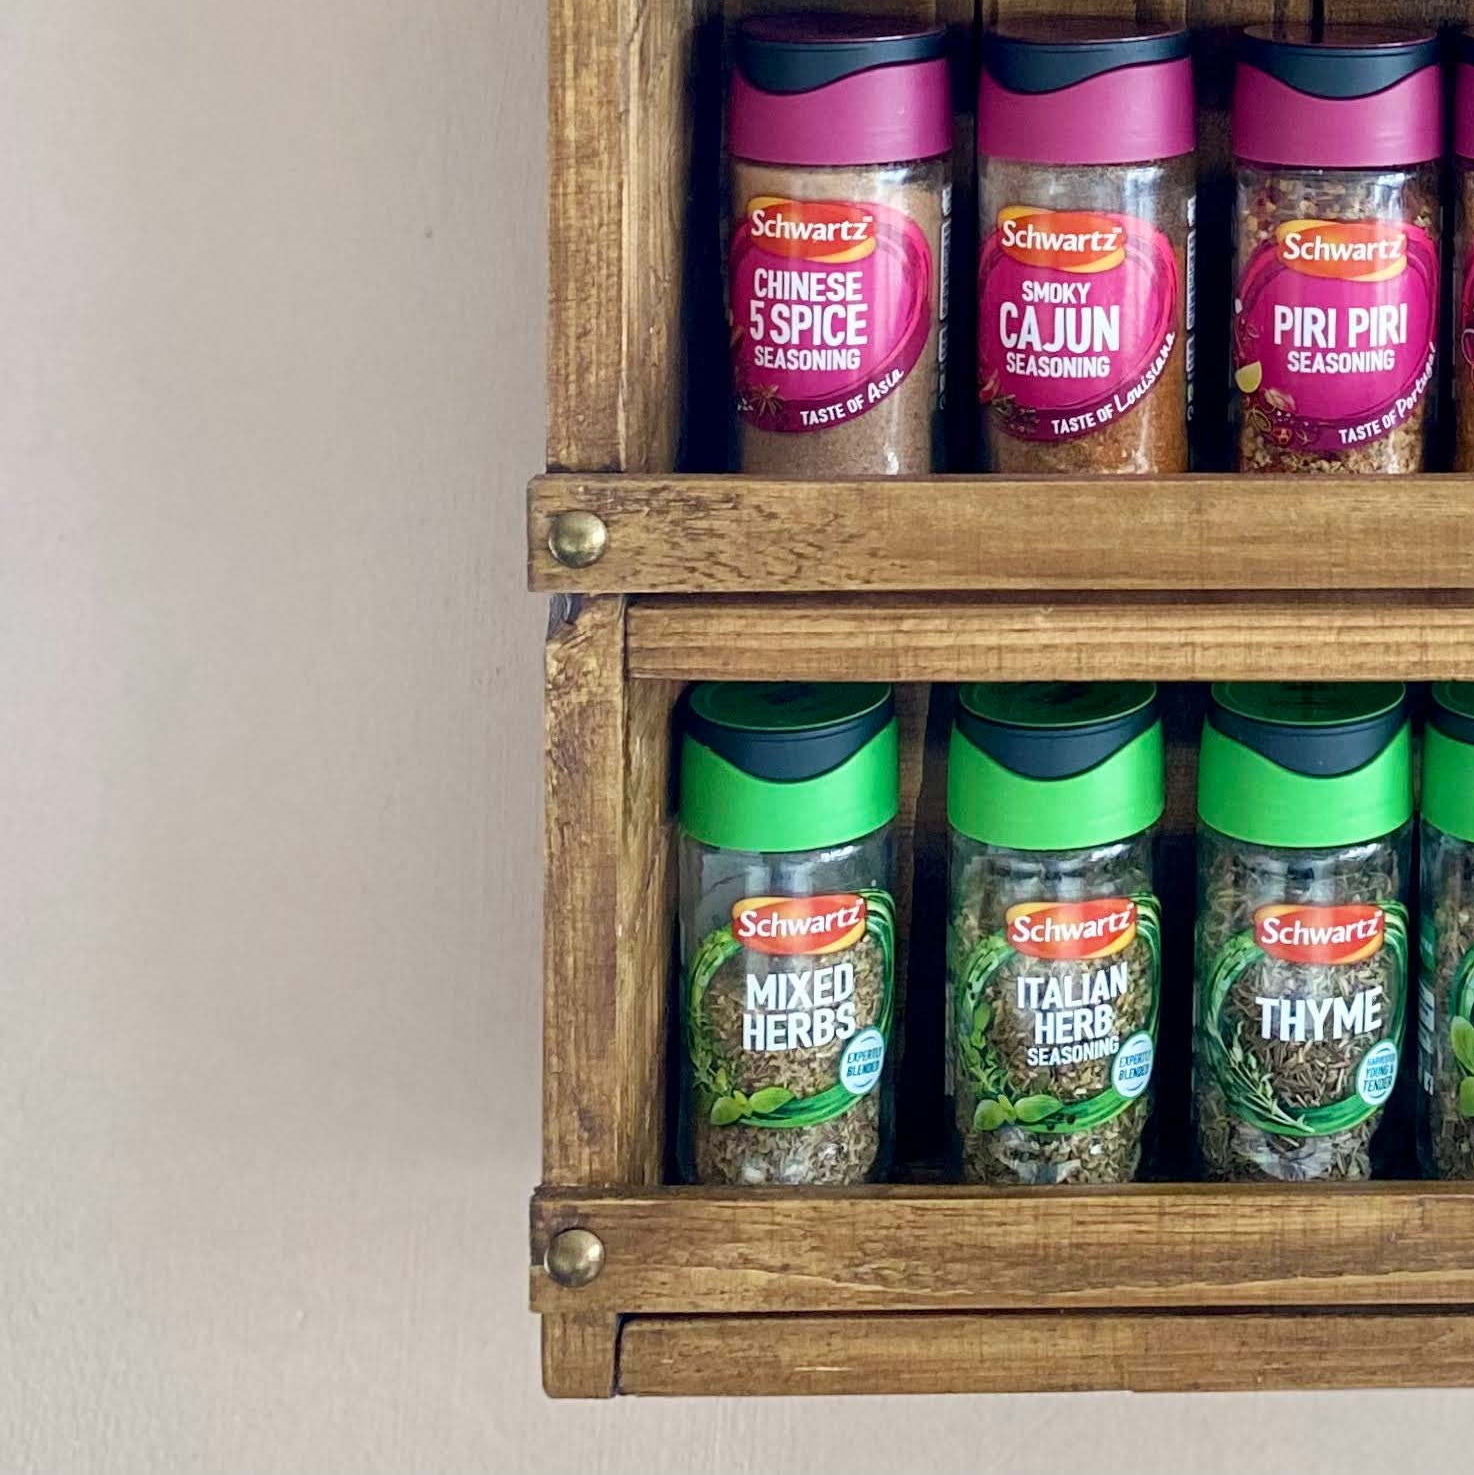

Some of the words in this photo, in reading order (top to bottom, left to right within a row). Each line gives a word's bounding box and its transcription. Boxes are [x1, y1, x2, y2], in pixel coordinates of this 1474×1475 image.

[751, 210, 868, 241] Schwartz
[1002, 219, 1117, 252] Schwartz
[1283, 233, 1402, 261] Schwartz
[754, 268, 863, 301] CHINESE
[1022, 281, 1091, 304] SMOKY
[750, 300, 765, 341] 5
[769, 303, 868, 346] SPICE
[999, 301, 1120, 354] CAJUN
[1273, 304, 1337, 349] PIRI
[1348, 302, 1408, 348] PIRI
[754, 346, 861, 371] SEASONING
[1006, 352, 1111, 378] SEASONING
[1287, 348, 1395, 374] SEASONING
[800, 403, 846, 426] TASTE
[847, 395, 865, 414] OF
[867, 368, 905, 403] Asia
[1051, 414, 1097, 435] TASTE
[1097, 404, 1114, 422] OF
[1114, 330, 1176, 414] Louisiana
[1338, 420, 1382, 444] TASTE
[1381, 409, 1397, 429] OF
[738, 906, 860, 938] Schwartz
[1012, 912, 1130, 942] Schwartz
[1261, 917, 1379, 946] Schwartz
[746, 963, 854, 1010] MIXED
[1017, 961, 1128, 1009] ITALIAN
[743, 1002, 856, 1051] HERBS
[1034, 1004, 1114, 1045] HERB
[1255, 985, 1383, 1042] THYME
[1027, 1035, 1119, 1067] SEASONING
